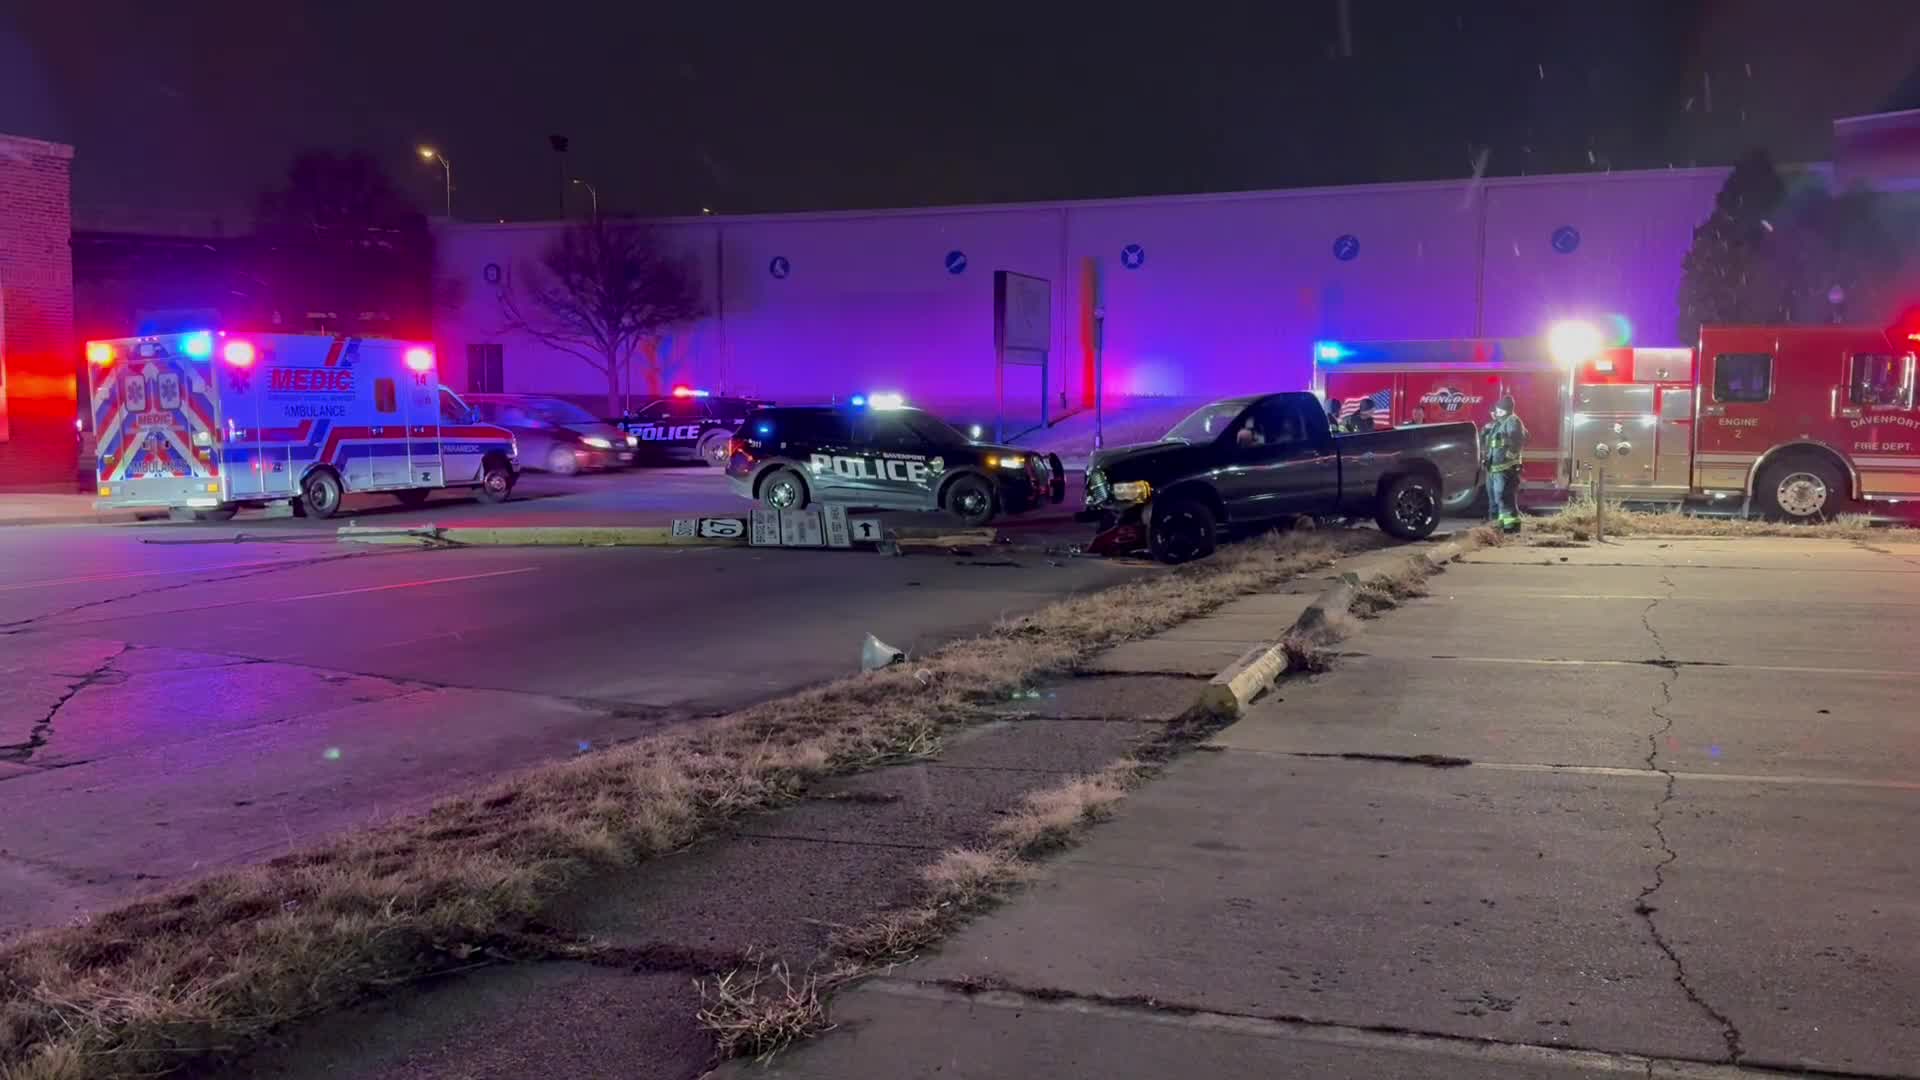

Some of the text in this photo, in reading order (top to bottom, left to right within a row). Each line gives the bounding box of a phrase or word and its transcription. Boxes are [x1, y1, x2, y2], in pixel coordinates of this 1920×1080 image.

[271, 367, 351, 392] MEDIC
[284, 404, 346, 417] AMBULANCE
[138, 414, 173, 425] MEDIC
[1718, 417, 1760, 427] ENGINE
[1850, 415, 1920, 429] DAVENPORT
[628, 424, 701, 441] POLICE
[1735, 429, 1743, 439] 2
[442, 444, 480, 454] PARAMEDIC
[1854, 441, 1878, 451] FIRE
[882, 452, 926, 461] DAVENPORT
[810, 453, 928, 483] POLICE
[710, 521, 737, 535] 67
